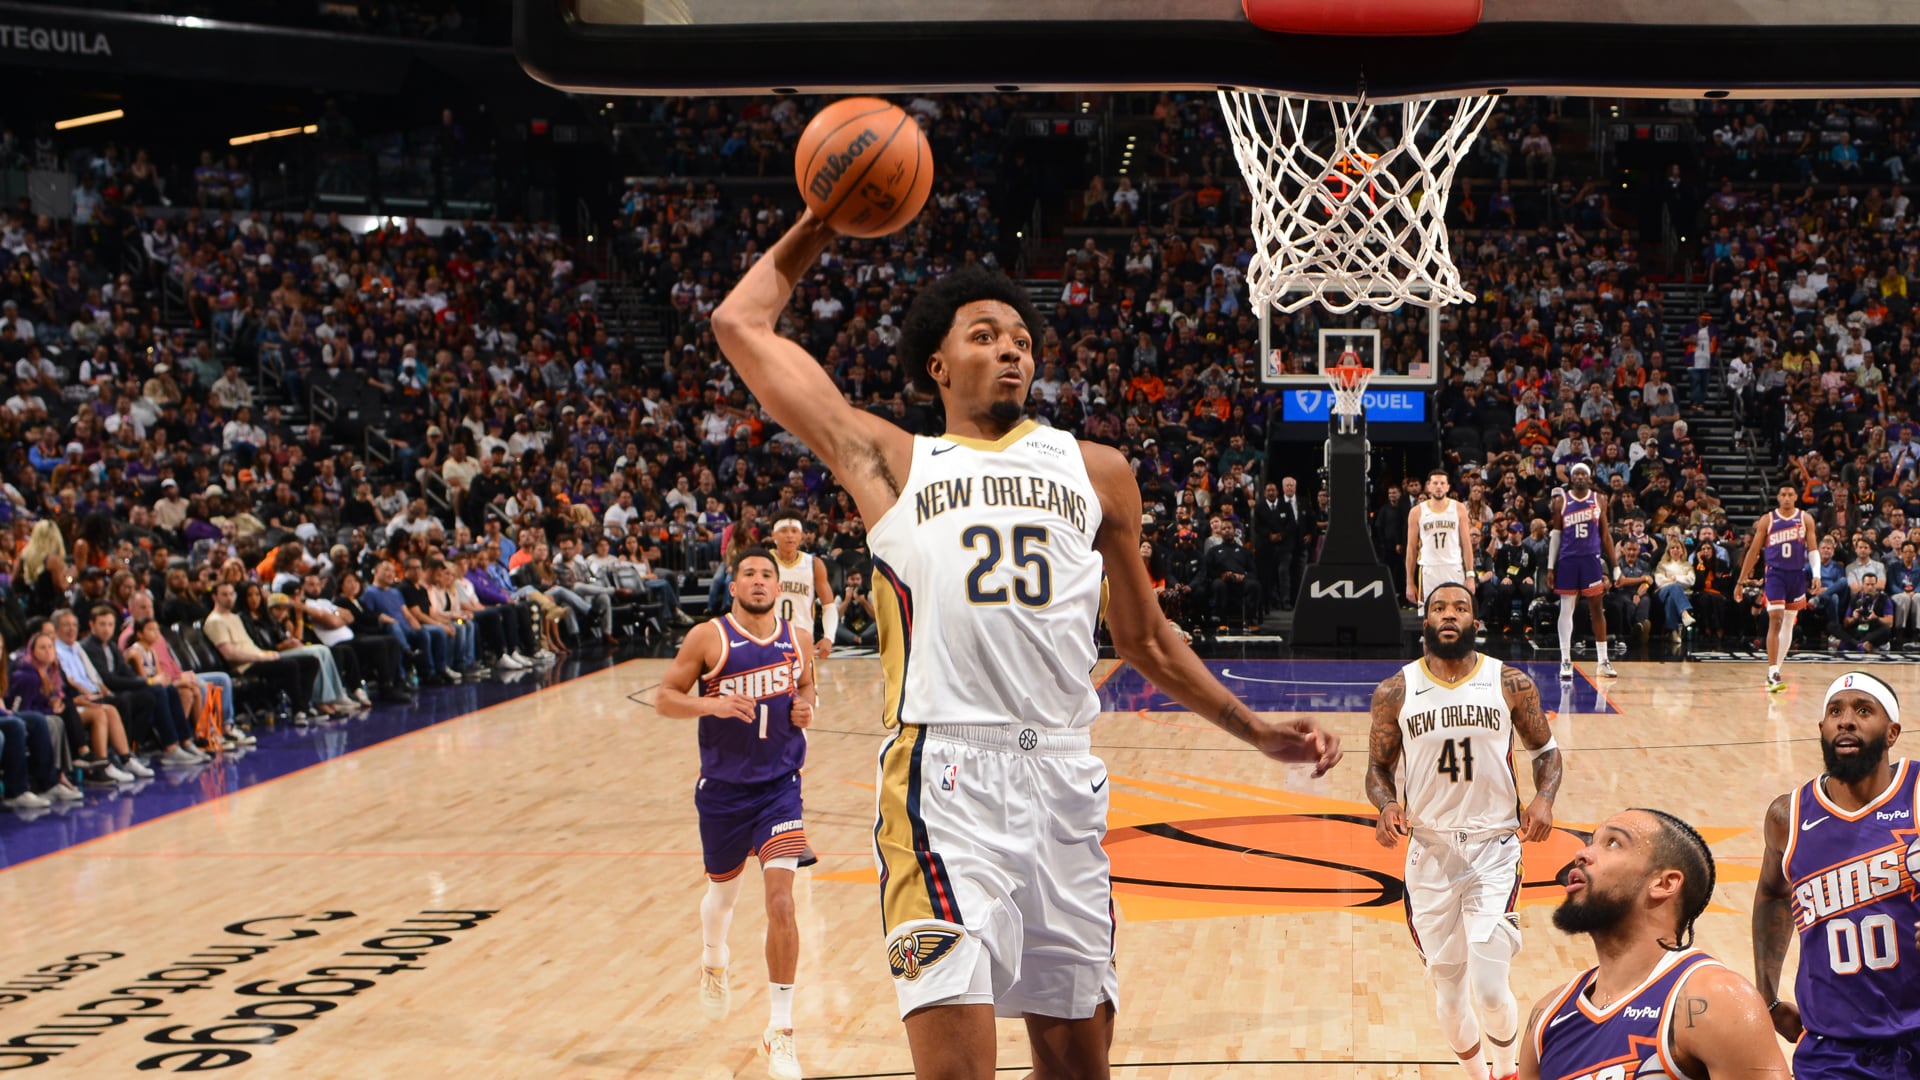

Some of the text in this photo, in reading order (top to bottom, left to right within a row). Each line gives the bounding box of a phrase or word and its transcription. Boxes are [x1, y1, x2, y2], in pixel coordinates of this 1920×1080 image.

[0, 24, 112, 56] TEQUILA
[810, 128, 878, 201] Wilson
[1327, 393, 1412, 409] FDUEL
[1026, 441, 1068, 456] NEWAGE
[915, 475, 1087, 535] NEW ORLEANS
[1433, 532, 1447, 549] 17
[1575, 523, 1588, 538] 15
[1781, 543, 1792, 558] 0
[960, 524, 1052, 609] 25
[1310, 580, 1383, 598] KIA
[759, 703, 769, 739] 1
[1406, 704, 1500, 741] NEW ORLEANS
[1437, 737, 1474, 783] 41
[1876, 809, 1909, 822] PayPal
[1826, 914, 1899, 975] 00
[136, 910, 500, 1072] mortgage
[1623, 1006, 1660, 1019] PayPal
[1685, 998, 1708, 1029] P
